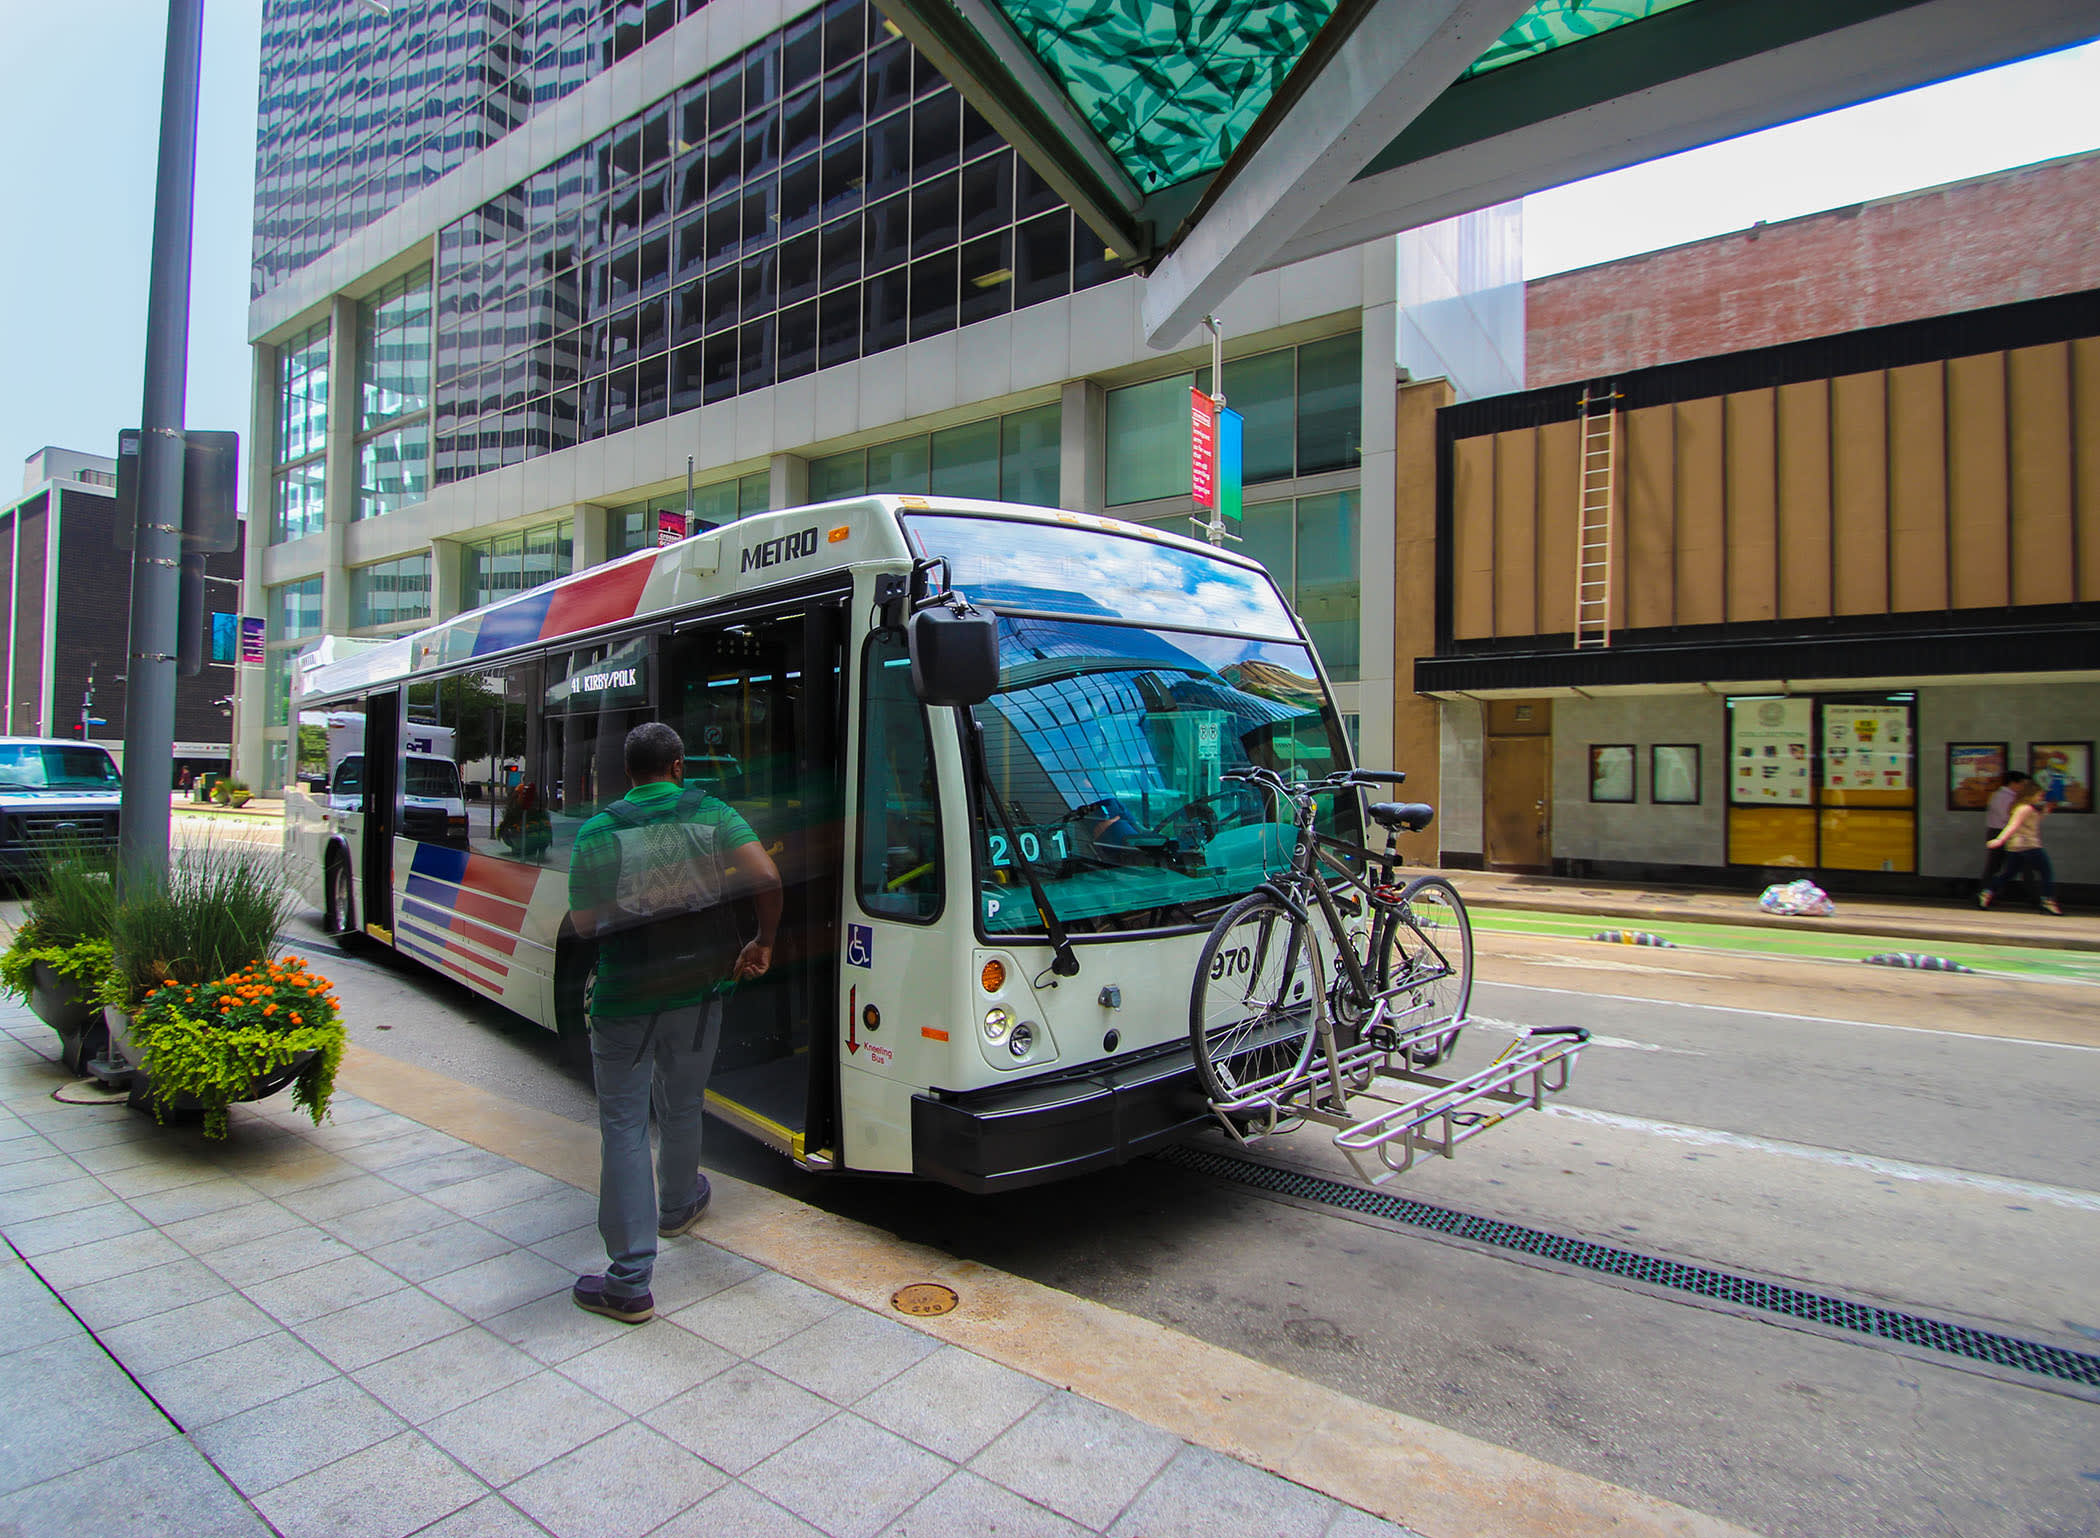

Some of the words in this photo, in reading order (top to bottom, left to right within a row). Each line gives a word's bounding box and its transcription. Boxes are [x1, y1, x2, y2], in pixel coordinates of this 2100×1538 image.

[740, 526, 818, 574] METRO
[571, 677, 581, 693] 41
[584, 668, 637, 692] KIRBY/POLK
[988, 900, 1000, 918] P
[863, 1041, 893, 1060] Kneeling
[871, 1053, 885, 1064] Bus
